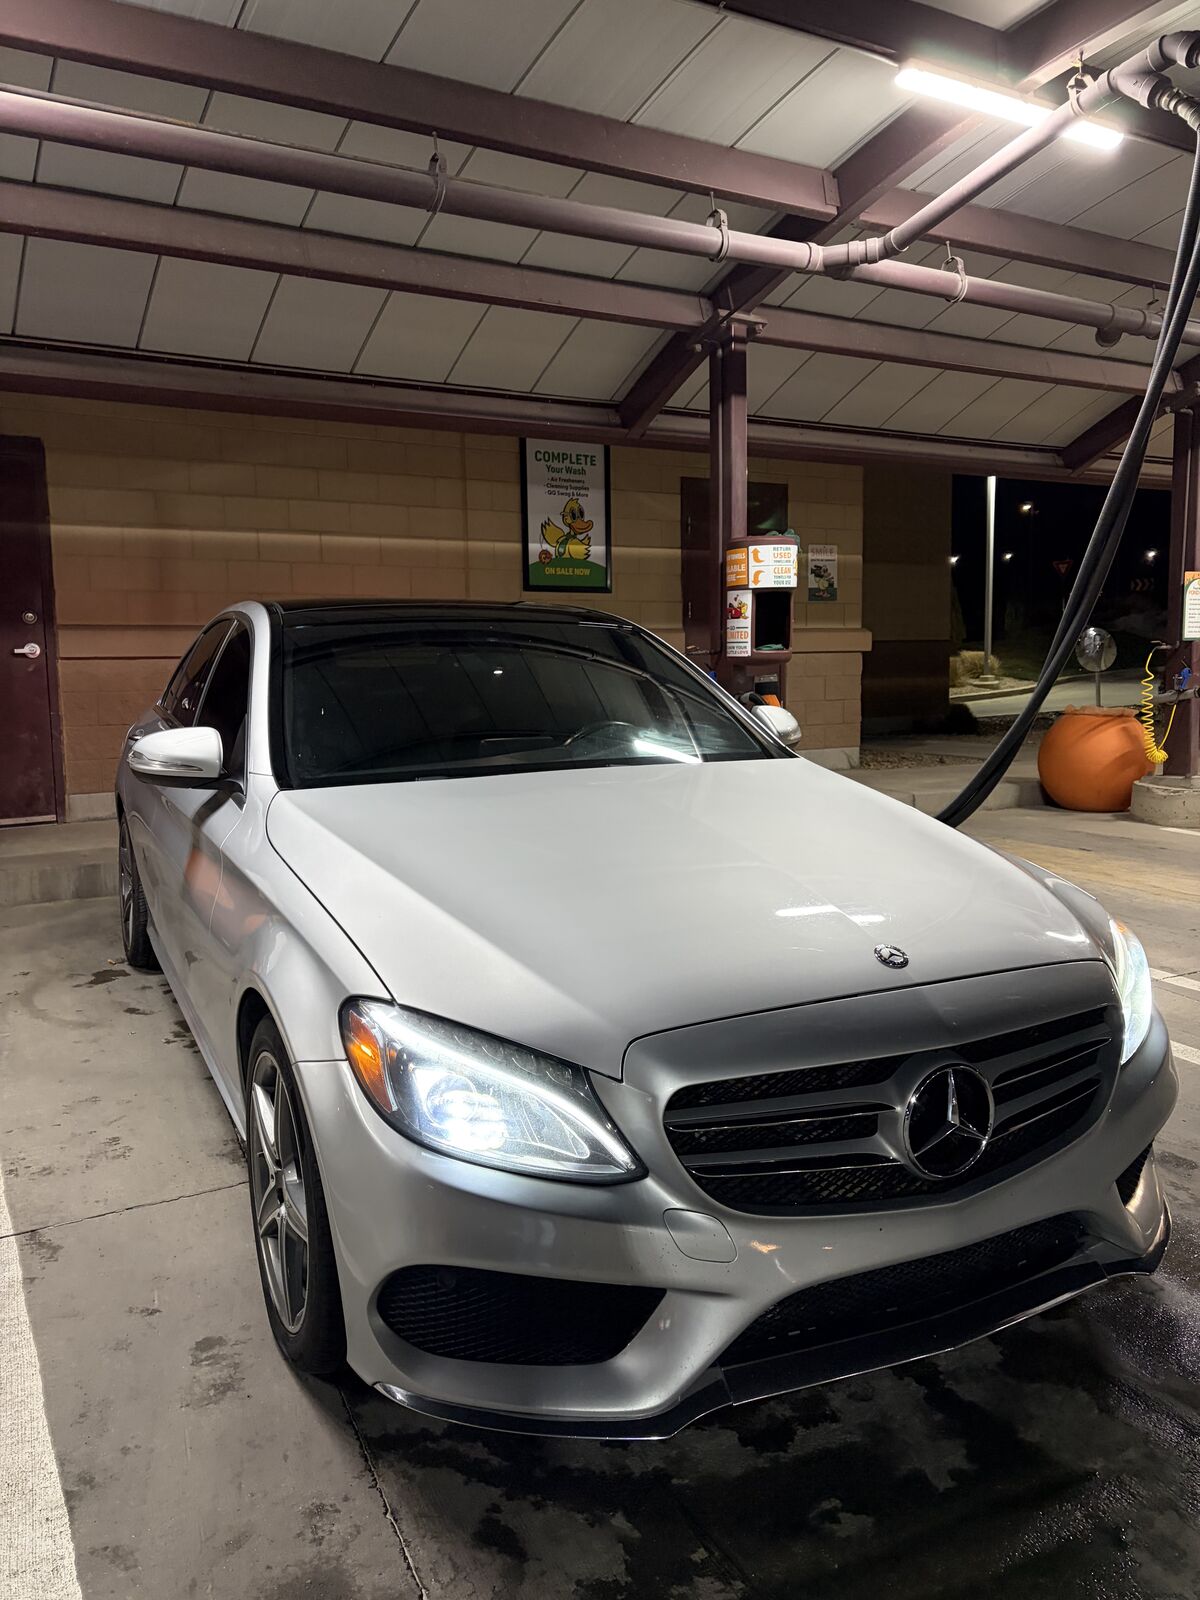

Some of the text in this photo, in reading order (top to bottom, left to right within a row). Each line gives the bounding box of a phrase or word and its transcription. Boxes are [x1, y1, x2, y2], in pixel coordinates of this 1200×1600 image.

[534, 450, 597, 466] COMPLETE
[545, 464, 586, 475] Your Wash
